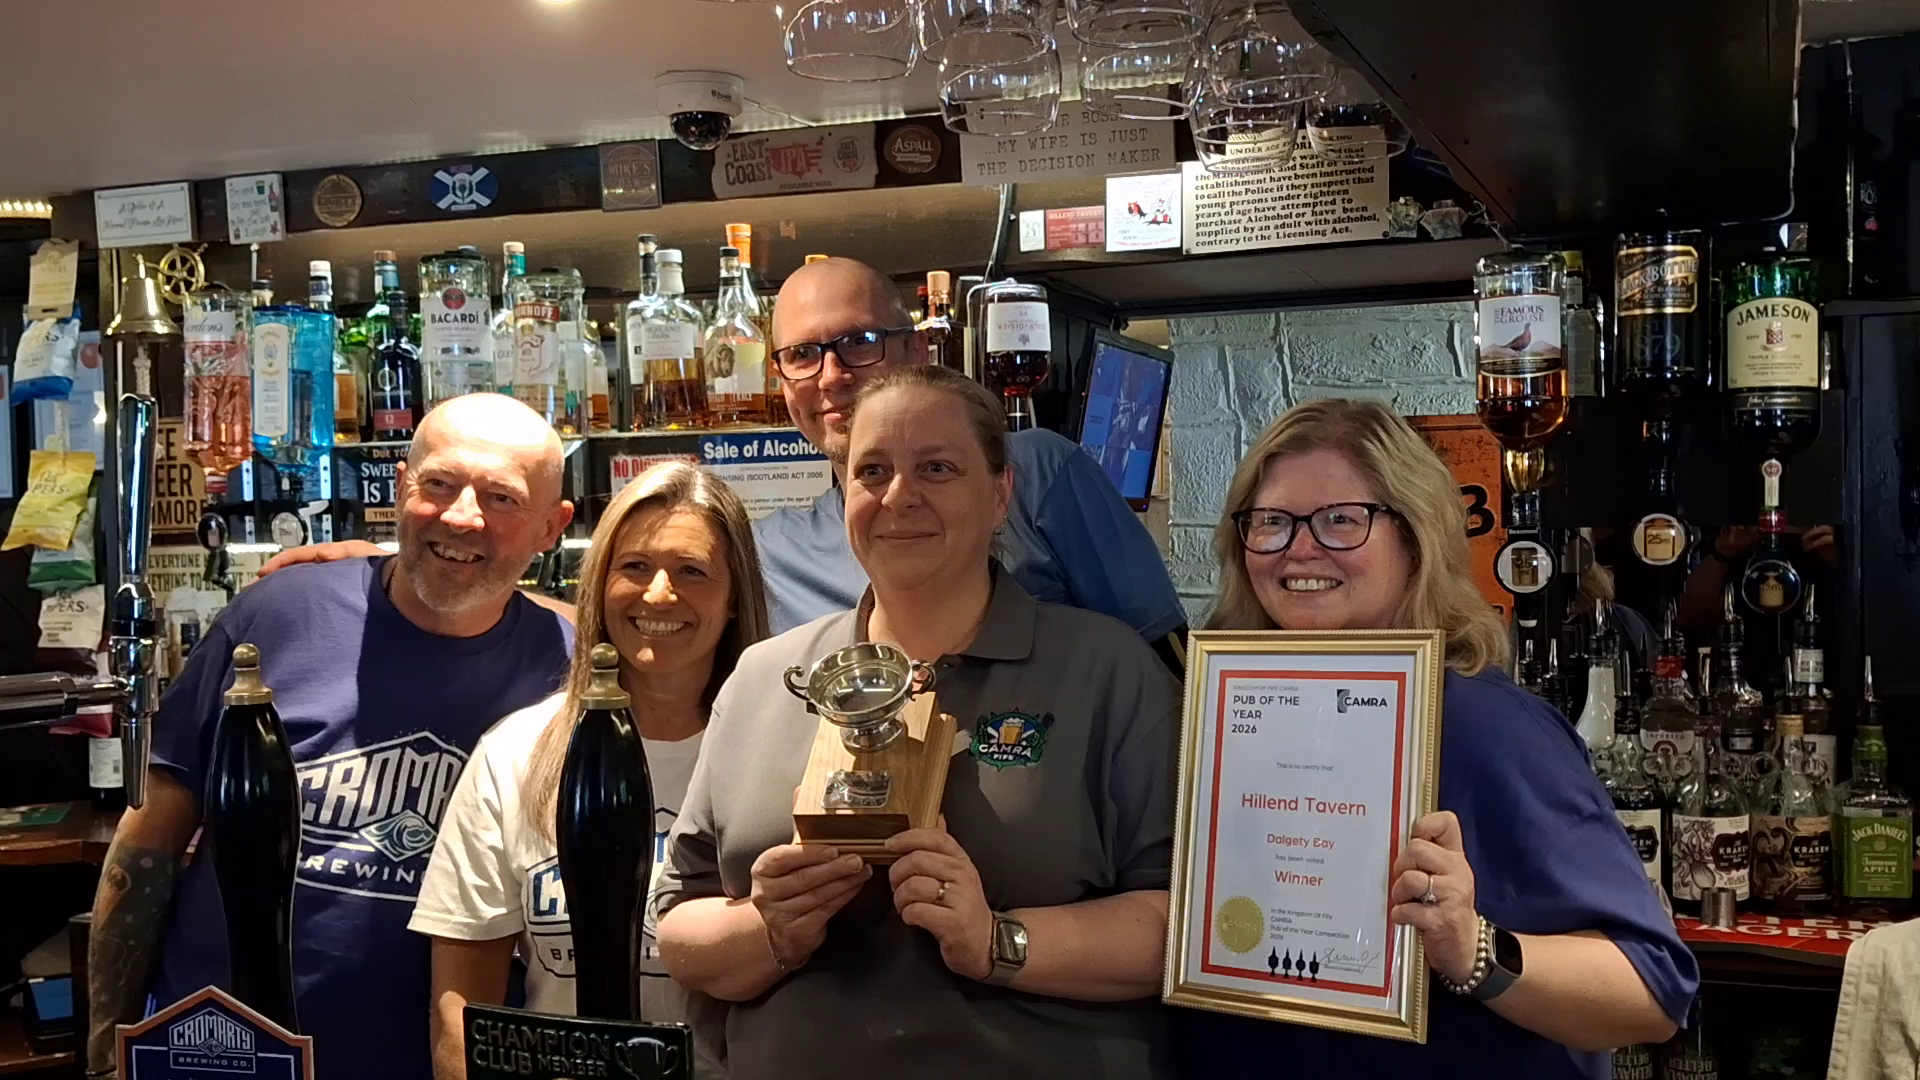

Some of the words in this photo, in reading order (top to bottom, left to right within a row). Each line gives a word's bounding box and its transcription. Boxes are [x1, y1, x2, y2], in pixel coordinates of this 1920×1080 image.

[894, 137, 934, 151] ASPALL
[1028, 135, 1069, 150] WIFE
[1080, 133, 1098, 146] IS
[1108, 128, 1148, 143] JUST
[730, 138, 765, 163] EAST
[784, 145, 807, 173] IPA
[977, 162, 1007, 176] THE
[1018, 154, 1096, 173] DECISION
[1107, 148, 1161, 166] MAKER
[1277, 163, 1297, 173] and
[1299, 159, 1326, 172] Staff
[1195, 176, 1266, 192] establishment
[1269, 174, 1293, 184] have
[1294, 171, 1318, 181] been
[1319, 166, 1375, 179] instructed
[1195, 192, 1205, 201] to
[1206, 189, 1226, 200] call
[1227, 188, 1243, 198] the
[1244, 185, 1275, 196] Police
[1276, 184, 1285, 193] if
[1285, 182, 1308, 194] they
[1310, 179, 1351, 191] suspect
[1351, 175, 1375, 185] that
[1195, 201, 1226, 212] young
[1229, 197, 1269, 209] persons
[1270, 192, 1301, 203] under
[1303, 187, 1350, 202] eighteen
[1194, 211, 1222, 222] years
[1223, 208, 1235, 218] of
[1235, 208, 1253, 219] age
[1254, 204, 1278, 214] have
[1280, 198, 1337, 213] attempted
[1340, 197, 1354, 205] to
[1195, 217, 1243, 230] purchase
[1246, 211, 1293, 224] Alchohol
[1294, 211, 1308, 219] or
[1311, 207, 1337, 217] have
[1341, 204, 1368, 214] been
[1195, 226, 1241, 238] supplied
[1243, 224, 1257, 235] by
[1273, 220, 1302, 230] adult
[1304, 217, 1330, 227] with
[1331, 213, 1380, 226] alchohol,
[1195, 236, 1241, 247] contrary
[1242, 234, 1254, 243] to
[1255, 232, 1272, 242] the
[1275, 227, 1328, 240] Licensing
[1330, 225, 1353, 235] Act.
[430, 311, 480, 325] BACARDÍ
[1500, 305, 1544, 316] FAMOUS
[1500, 313, 1544, 324] GROUSE
[1736, 304, 1811, 327] JAMESON
[372, 448, 391, 459] DUE
[703, 442, 739, 459] Sale
[743, 441, 759, 455] of
[763, 438, 822, 455] Alcoho
[361, 462, 397, 478] SWEE
[613, 459, 629, 478] NO
[746, 472, 790, 481] (SCOTLAND)
[791, 471, 805, 479] ACT
[806, 471, 824, 479] 2005
[362, 480, 381, 504] IS
[1233, 695, 1256, 705] PUB
[1259, 695, 1275, 705] OF
[1277, 696, 1300, 706] THE
[1344, 697, 1388, 708] CAMRA
[1232, 709, 1262, 720] YEAR
[1231, 723, 1258, 734] 2026
[979, 743, 1032, 757] CAMRA
[299, 746, 463, 828] CROMA
[1241, 793, 1299, 812] Hillend
[1304, 797, 1367, 816] Tavern
[1267, 834, 1310, 849] Dalgety
[1313, 837, 1336, 850] Bay
[1851, 825, 1874, 842] JACK
[1793, 845, 1830, 854] KRAKEN
[1275, 853, 1287, 862] has
[1288, 854, 1304, 863] been
[1305, 857, 1325, 865] voted
[1274, 870, 1324, 887] Winner
[1287, 909, 1313, 918] Kingdom
[1315, 930, 1351, 939] Competition
[1695, 924, 1869, 941] AGER
[173, 1014, 252, 1050] CROMARTY
[471, 1019, 611, 1060] CHAMPION
[179, 1057, 228, 1067] BREWING
[232, 1060, 251, 1068] CO.
[472, 1044, 533, 1076] CLUB
[537, 1054, 609, 1077] MEMBER
